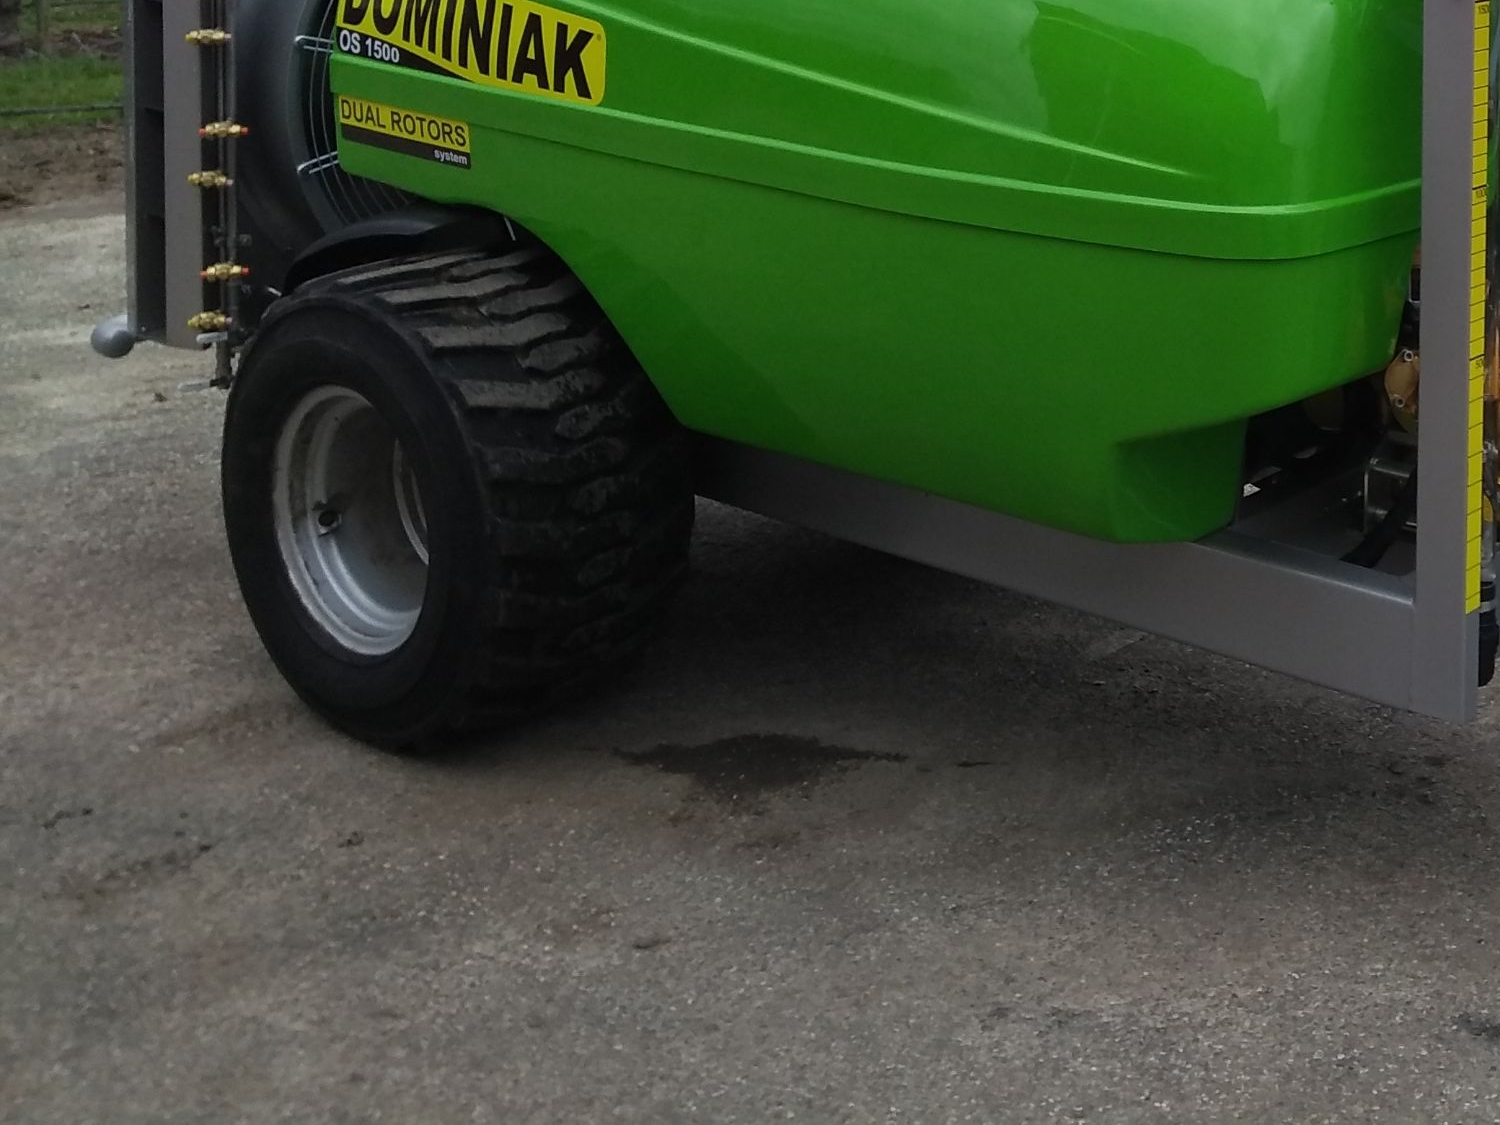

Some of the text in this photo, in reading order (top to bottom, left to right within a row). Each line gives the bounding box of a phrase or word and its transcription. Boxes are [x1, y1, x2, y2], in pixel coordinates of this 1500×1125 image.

[339, 29, 400, 64] OS 1500
[340, 98, 467, 148] DUAL ROTORS
[432, 148, 468, 166] system
